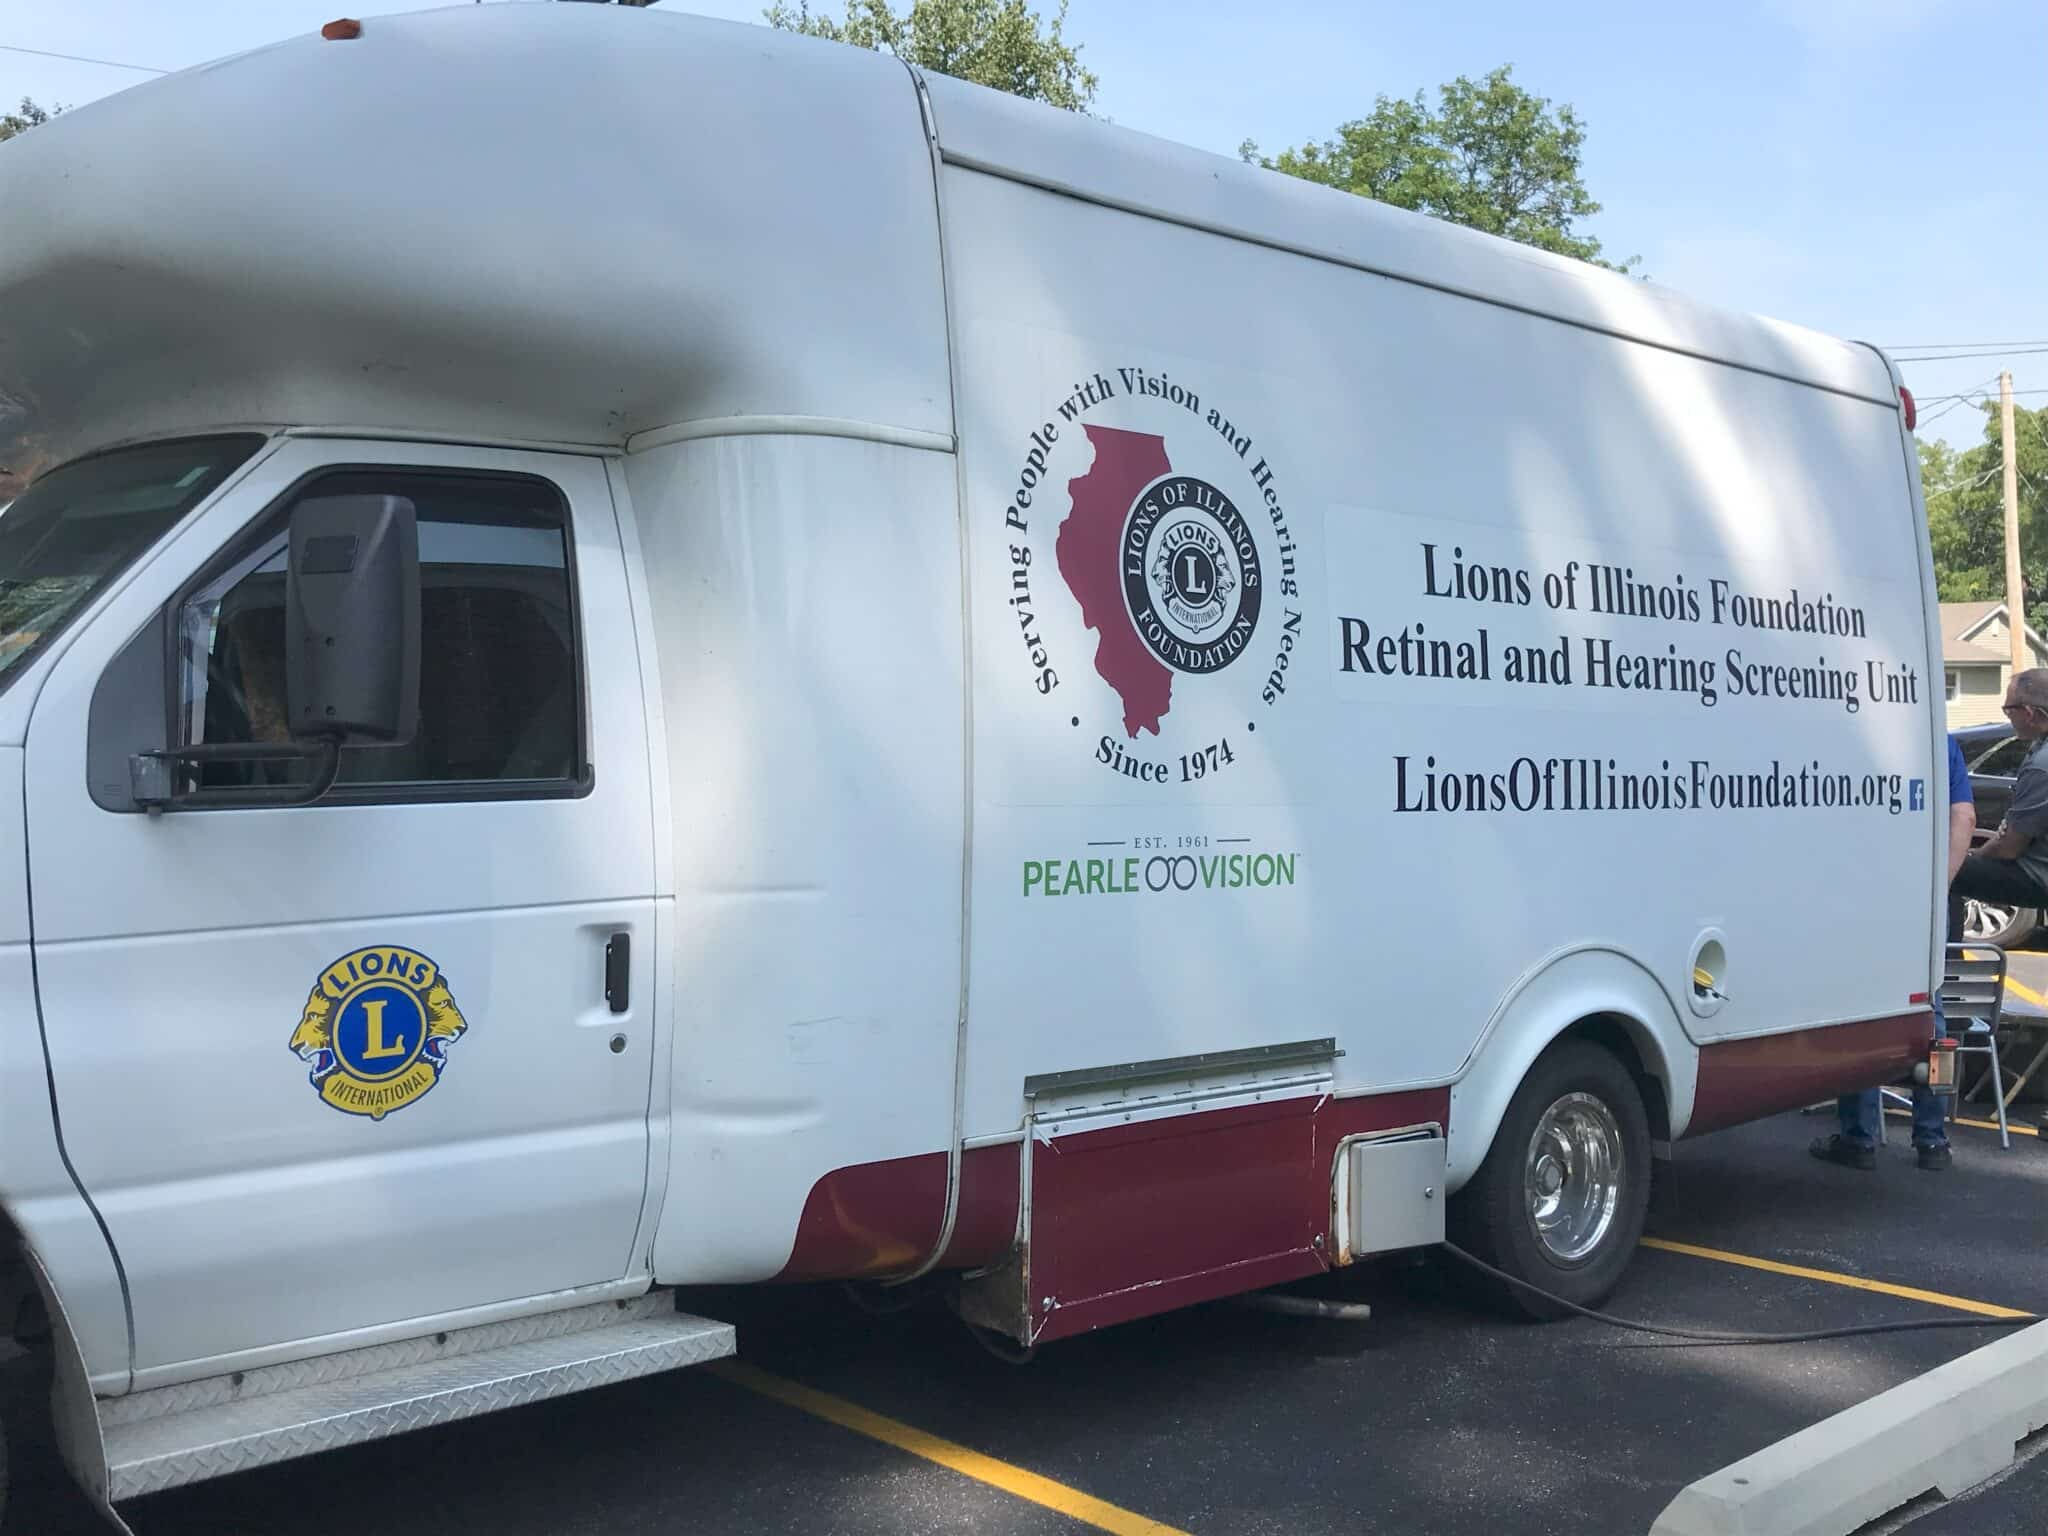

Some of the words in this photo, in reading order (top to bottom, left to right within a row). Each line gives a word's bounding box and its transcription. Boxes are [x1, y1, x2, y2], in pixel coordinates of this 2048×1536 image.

[1057, 373, 1116, 424] with
[1118, 367, 1201, 415] Vision
[1206, 407, 1252, 460] and
[1005, 421, 1060, 534] People
[1128, 499, 1160, 577] LIONS
[1163, 483, 1188, 505] OF
[1197, 486, 1257, 588] ILLINOIS
[1169, 525, 1217, 551] LIONS
[1249, 457, 1300, 600] Hearing
[1184, 555, 1207, 594] L
[1421, 543, 1531, 606] Lions
[1543, 561, 1580, 610] of
[1589, 564, 1700, 623] Illinois
[1709, 579, 1867, 638] Foundation
[1008, 543, 1060, 695] Serving
[1138, 608, 1252, 669] FOUNDATION
[1171, 606, 1219, 625] INTERNATIONAL
[1262, 607, 1303, 707] Needs
[1338, 616, 1492, 681] Retinal
[1504, 636, 1572, 686] and
[1582, 638, 1718, 707] Hearing
[1725, 649, 1859, 713] Screening
[1866, 661, 1919, 704] Unit
[1095, 735, 1169, 784] Since
[1180, 737, 1235, 783] 1974
[1392, 755, 1903, 815] LionsOfIllinoisFoundation.org
[1134, 837, 1167, 848] EST.
[1177, 836, 1209, 848] 1961
[1023, 858, 1140, 896] PEARLE
[1199, 853, 1295, 889] VISION
[328, 953, 429, 992] LIONS
[361, 1000, 405, 1059] L
[330, 1071, 428, 1106] INTERNATIONAL
